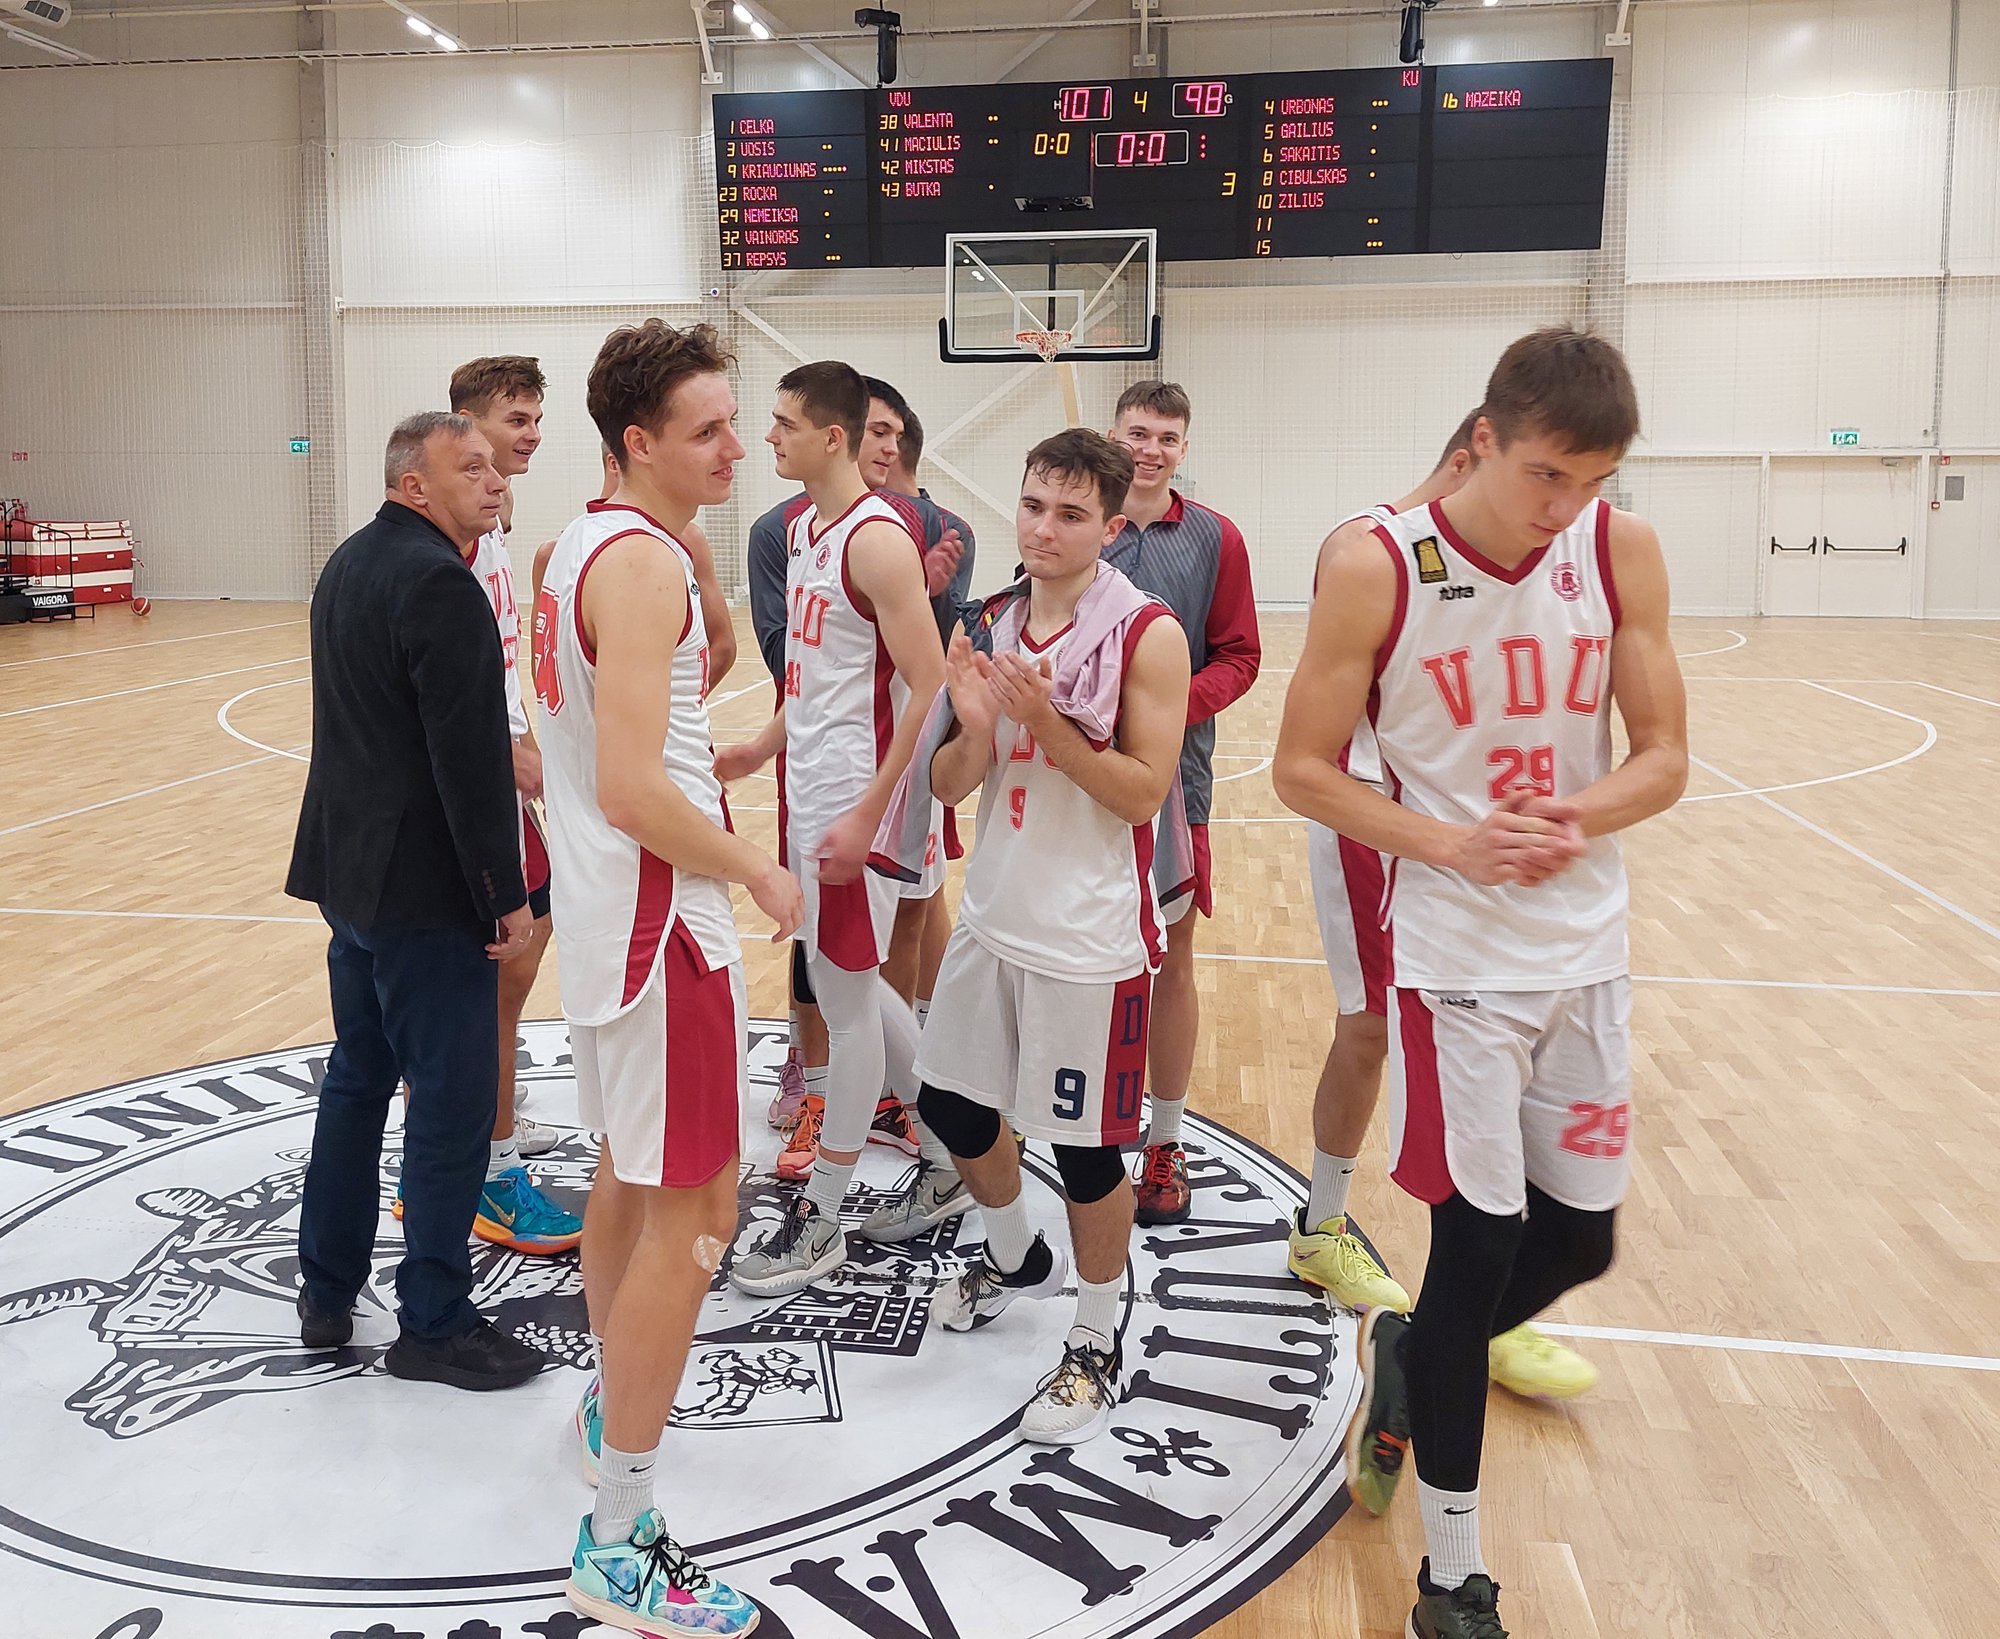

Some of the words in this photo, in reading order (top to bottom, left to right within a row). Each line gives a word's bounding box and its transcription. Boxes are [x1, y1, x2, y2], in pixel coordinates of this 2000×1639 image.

[1402, 70, 1420, 86] KU
[889, 92, 911, 106] VDU
[1054, 101, 1061, 109] H
[1063, 89, 1110, 119] 101
[1134, 91, 1147, 112] 4
[1186, 85, 1223, 113] 98
[1224, 95, 1233, 103] G
[1265, 100, 1274, 114] 4
[1281, 98, 1334, 114] URBONAS
[1442, 93, 1458, 108] 16
[1465, 90, 1521, 108] MAZEIKA
[730, 121, 734, 134] 1
[739, 120, 774, 134] CELKA
[879, 115, 897, 129] 38
[903, 113, 953, 128] VALENTA
[1264, 125, 1274, 139] 5
[1280, 122, 1334, 139] GAILIUS
[727, 143, 736, 157] 3
[880, 137, 899, 152] 41
[904, 136, 961, 151] MACIULIS
[1035, 133, 1070, 155] 0:0
[1118, 133, 1165, 163] 0:0
[1263, 148, 1272, 162] 6
[1280, 146, 1340, 162] SAKAITIS
[728, 165, 737, 179] 9
[742, 163, 816, 179] KRIAUCIUNAS
[881, 160, 899, 175] 42
[905, 159, 954, 174] MIKSTAS
[1221, 172, 1235, 195] 3
[1263, 171, 1272, 186] 8
[1279, 169, 1347, 186] CIBULSKAS
[719, 187, 737, 201] 23
[743, 187, 777, 201] ROCKA
[882, 183, 900, 197] 43
[905, 182, 941, 197] BUTKA
[1258, 194, 1272, 209] 10
[1279, 193, 1324, 209] ZILIUS
[720, 209, 738, 223] 29
[744, 208, 798, 223] NEMEIKSA
[1257, 217, 1272, 231] 11
[722, 231, 739, 245] 32
[745, 230, 799, 245] VAINORAS
[1257, 240, 1271, 254] 15
[724, 253, 741, 267] 37
[746, 252, 787, 267] REPSYS
[32, 594, 68, 607] VAIGORA
[1052, 1067, 1087, 1121] 9
